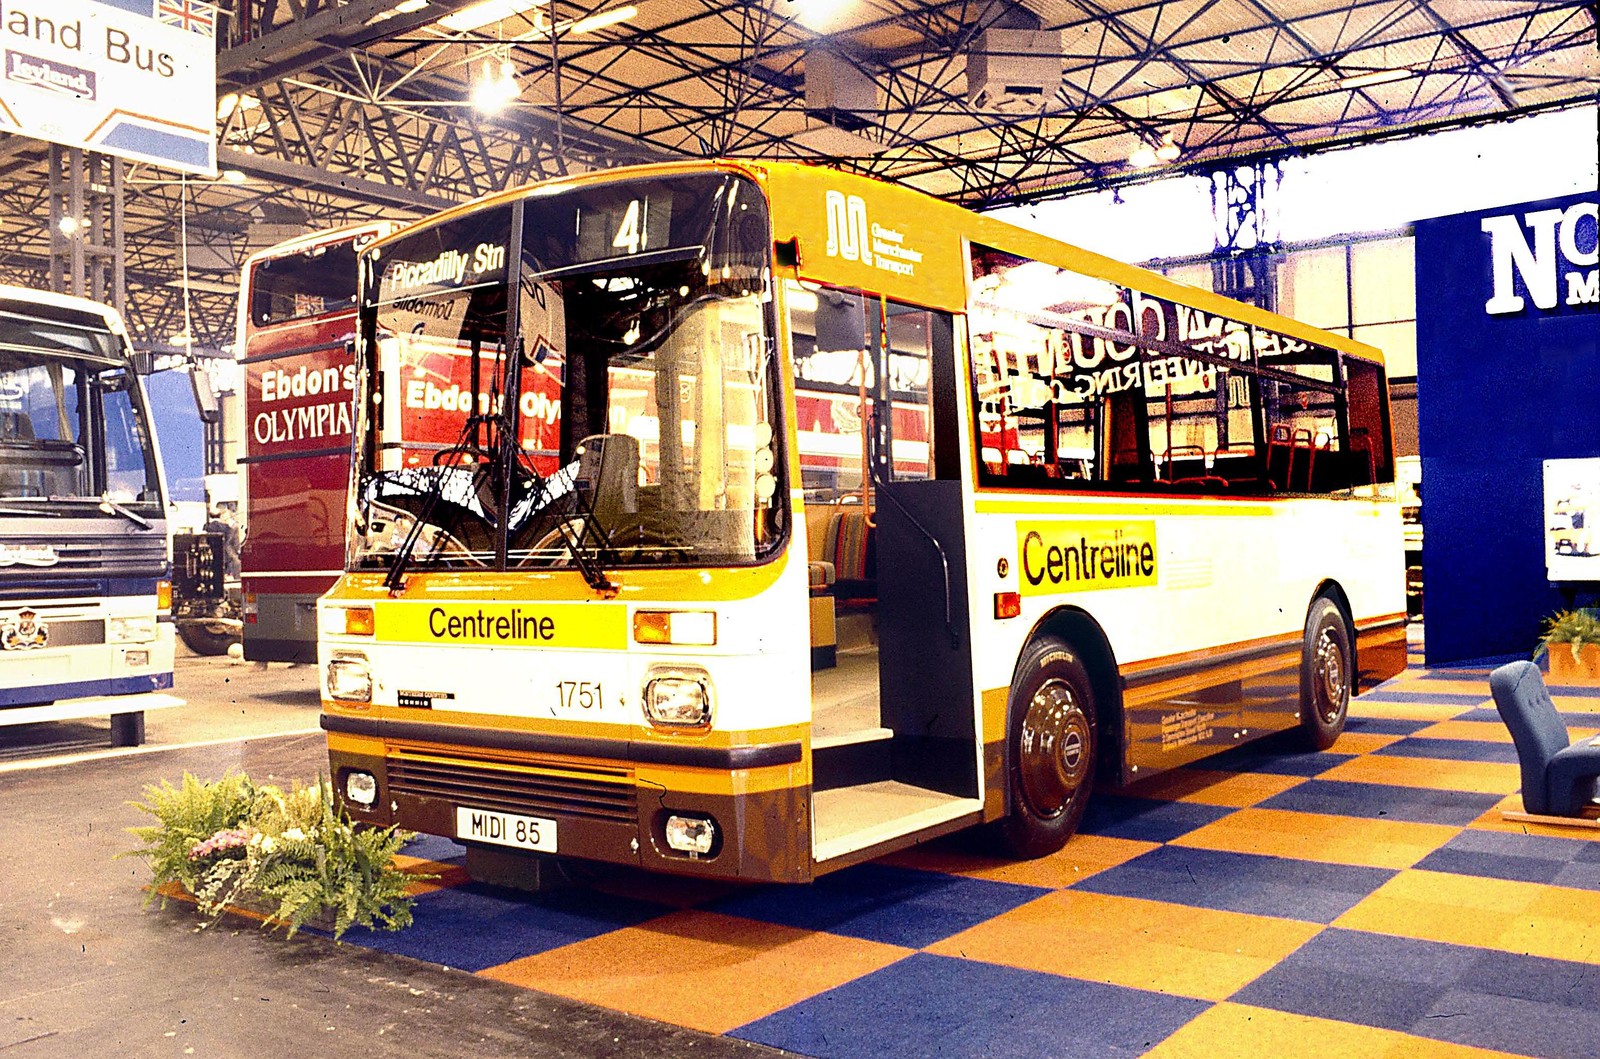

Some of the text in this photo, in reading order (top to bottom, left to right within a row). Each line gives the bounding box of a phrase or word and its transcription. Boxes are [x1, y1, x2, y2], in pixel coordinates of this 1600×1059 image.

[106, 27, 174, 77] Bus
[10, 53, 93, 97] Leyland
[612, 200, 640, 254] 4
[391, 243, 505, 292] Piccadilly Stn
[261, 364, 356, 402] Ebdon's
[1023, 529, 1154, 586] Centreline
[429, 607, 555, 640] Centreline
[556, 681, 603, 709] 1751
[472, 813, 541, 845] MIDI 85
